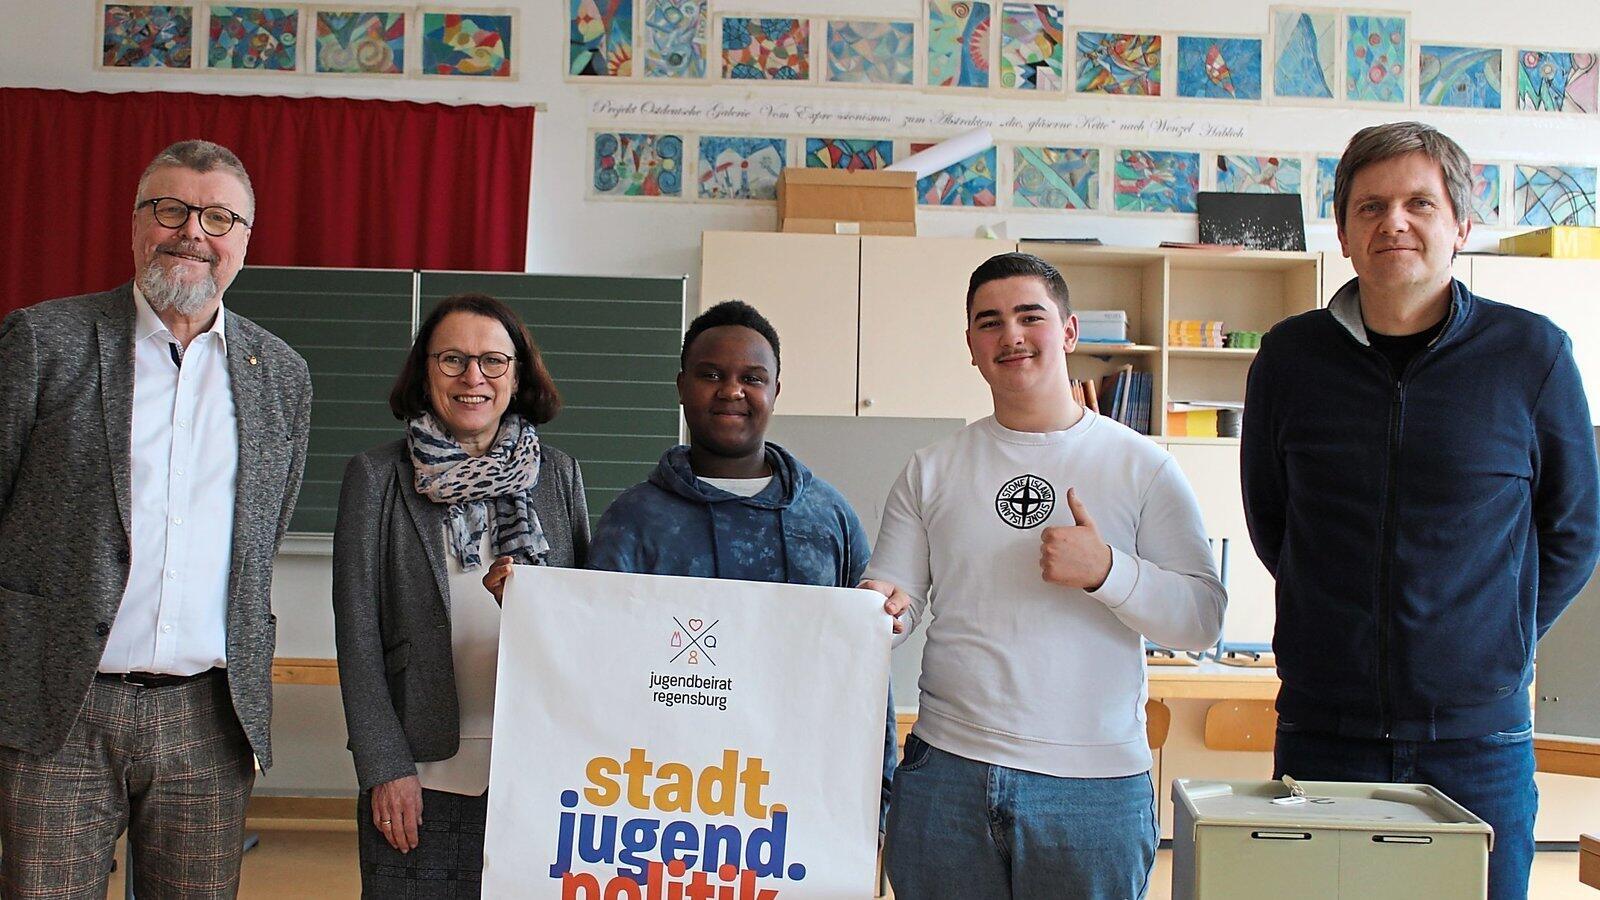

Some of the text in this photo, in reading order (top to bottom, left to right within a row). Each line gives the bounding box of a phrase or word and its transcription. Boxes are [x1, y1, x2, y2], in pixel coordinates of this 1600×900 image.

[593, 99, 637, 117] Projekt
[640, 100, 701, 116] Ostdeutsche
[706, 102, 751, 118] Galerie
[759, 103, 790, 118] Vom
[901, 114, 926, 127] zum
[930, 109, 993, 127] Abstrakten
[1119, 119, 1146, 132] nach
[1149, 117, 1194, 137] Wenzel
[1002, 478, 1051, 499] STONE ISLAND
[1000, 502, 1050, 525] STONE ISLAND
[649, 671, 733, 690] jugendbeirat
[653, 690, 727, 711] regensburg
[583, 747, 789, 820] stadt.
[549, 789, 807, 886] jugend.
